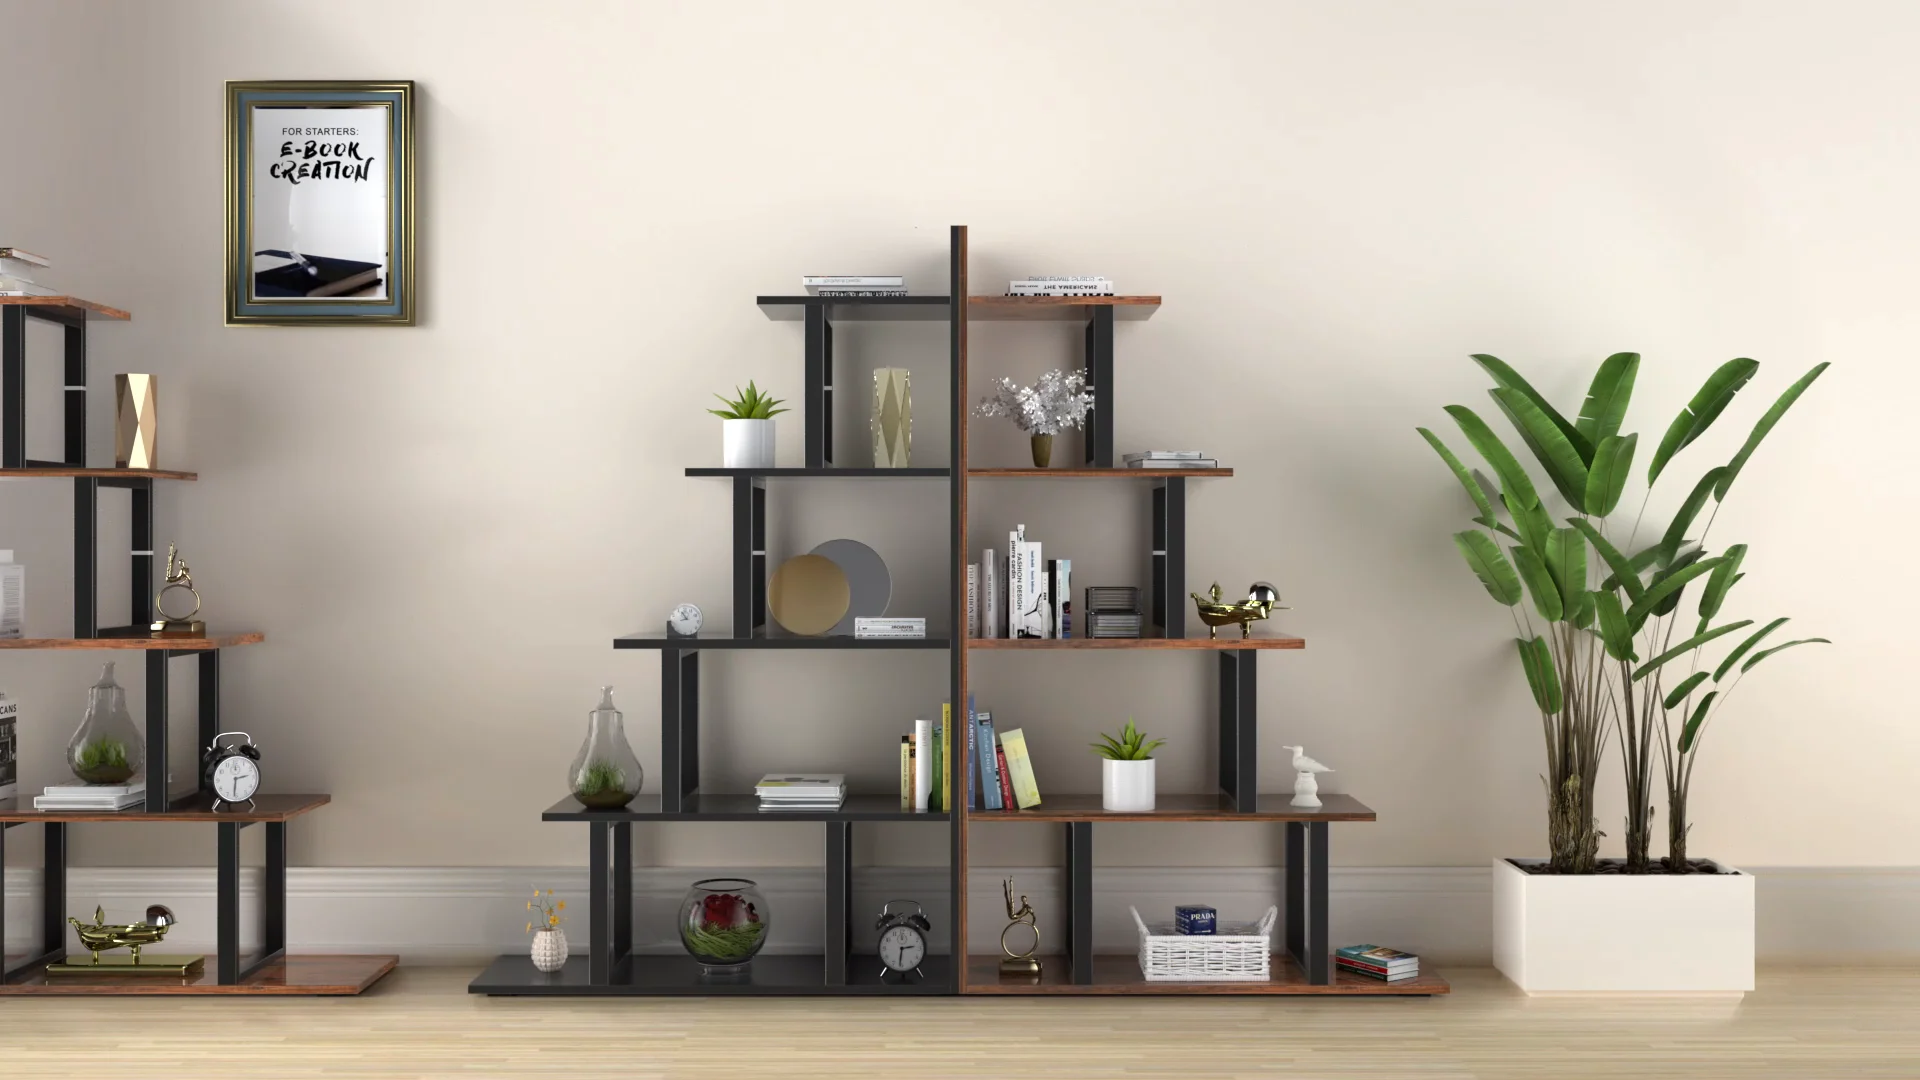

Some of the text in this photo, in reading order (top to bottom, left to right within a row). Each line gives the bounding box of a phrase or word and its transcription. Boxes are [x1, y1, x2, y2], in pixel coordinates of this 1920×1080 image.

[282, 127, 359, 136] FOR STARTERS:
[279, 140, 363, 161] E-BOOK
[270, 157, 375, 185] CREATION
[1190, 912, 1215, 921] PRADA
